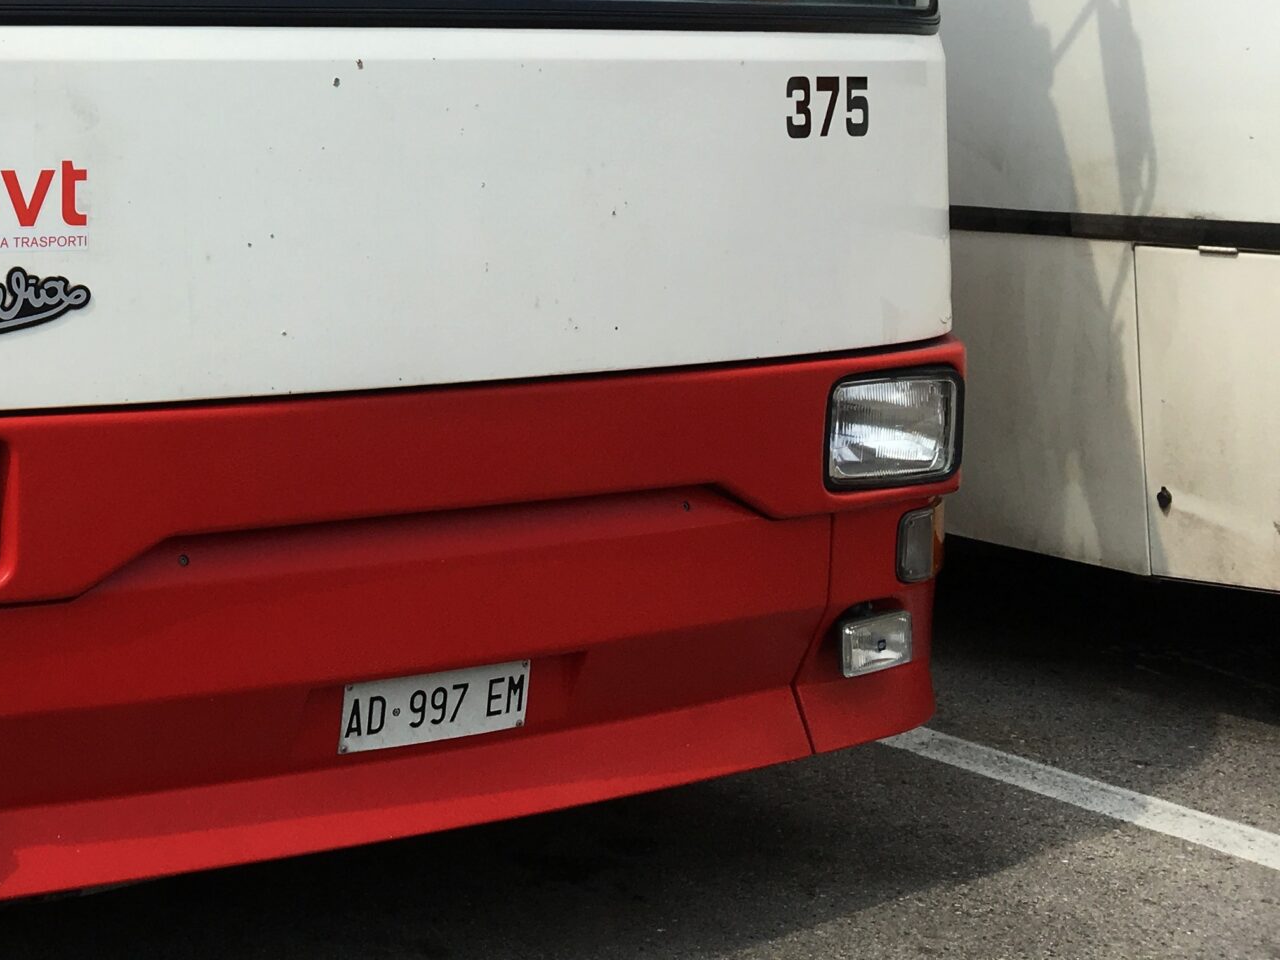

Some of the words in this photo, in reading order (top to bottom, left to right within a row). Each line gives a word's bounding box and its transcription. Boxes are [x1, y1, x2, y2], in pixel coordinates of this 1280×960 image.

[786, 76, 869, 139] 375
[13, 235, 87, 248] TRASPORTI
[344, 695, 387, 738] AD
[409, 682, 470, 728] 997
[485, 673, 526, 717] EM
